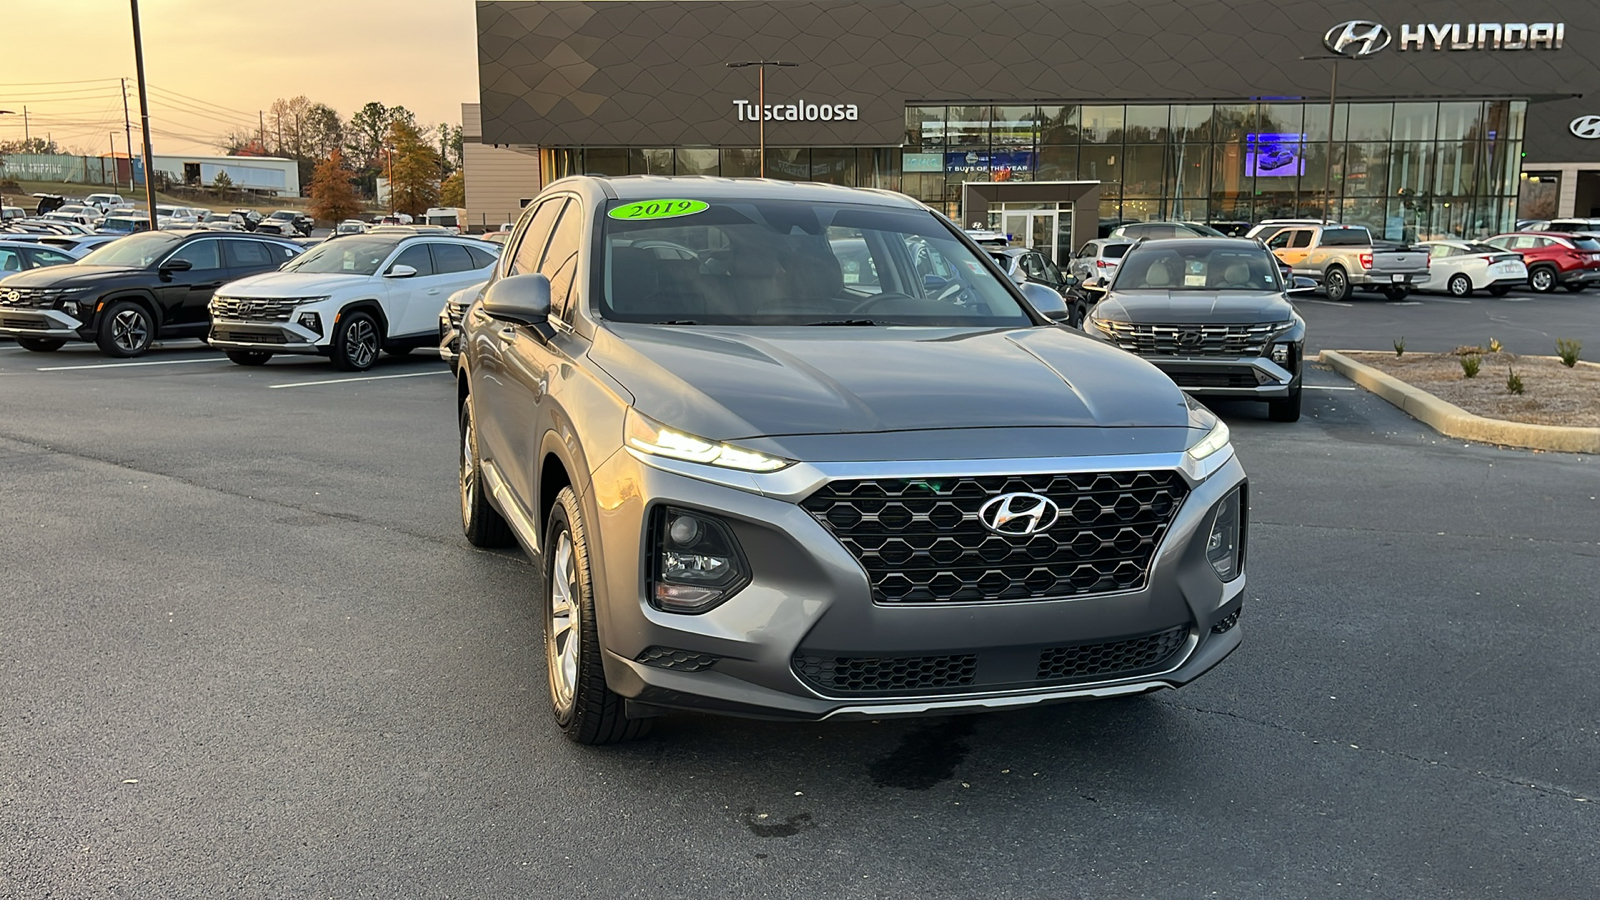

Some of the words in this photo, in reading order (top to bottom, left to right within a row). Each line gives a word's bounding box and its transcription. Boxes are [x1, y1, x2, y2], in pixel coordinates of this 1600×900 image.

[1401, 22, 1565, 50] HYUNDAI
[733, 99, 858, 121] Tuscaloosa
[5, 162, 26, 172] CHINA
[29, 163, 62, 173] SHIPPING
[629, 201, 692, 218] 2019
